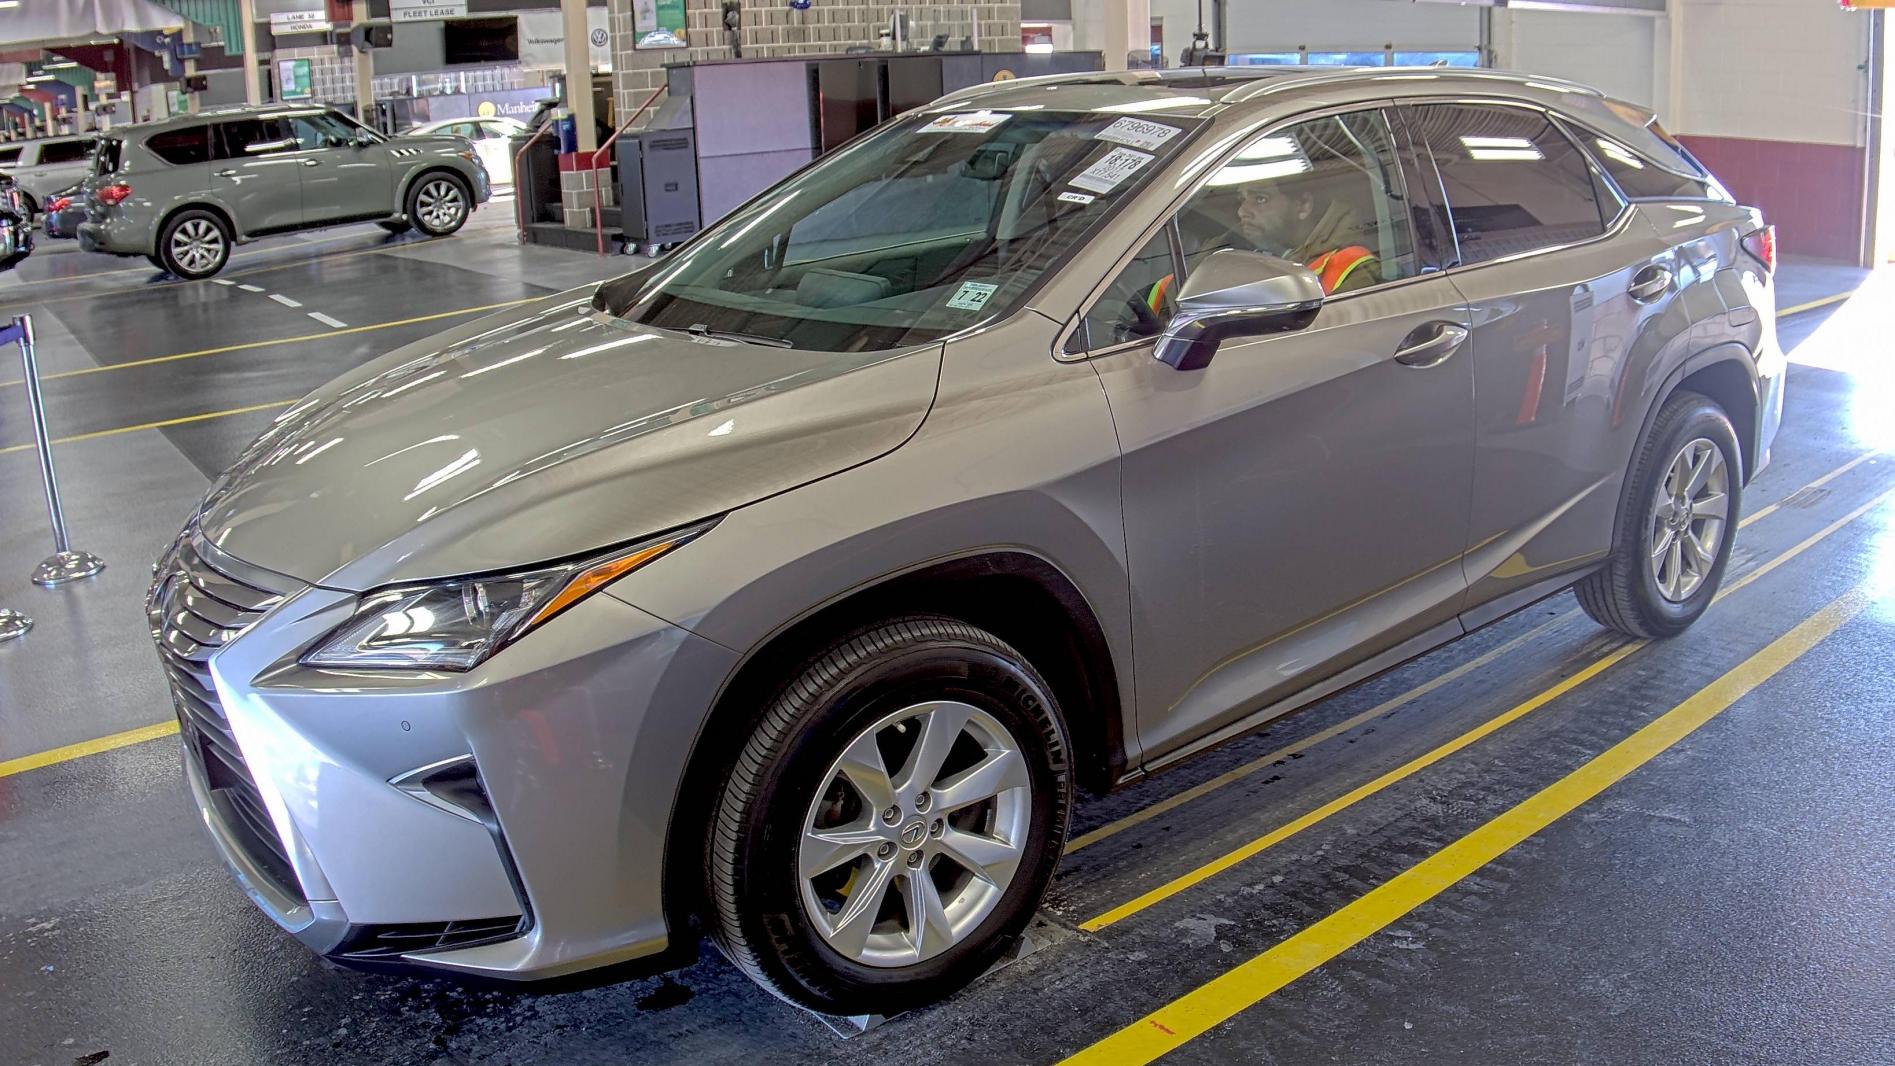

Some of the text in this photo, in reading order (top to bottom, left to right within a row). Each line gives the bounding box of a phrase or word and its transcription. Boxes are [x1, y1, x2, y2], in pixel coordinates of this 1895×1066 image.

[403, 8, 455, 18] FLEET LEASE
[496, 101, 536, 115] Manhei
[1112, 119, 1172, 138] 6796978
[958, 290, 988, 303] 7 22
[1000, 673, 1067, 767] MICHELIN
